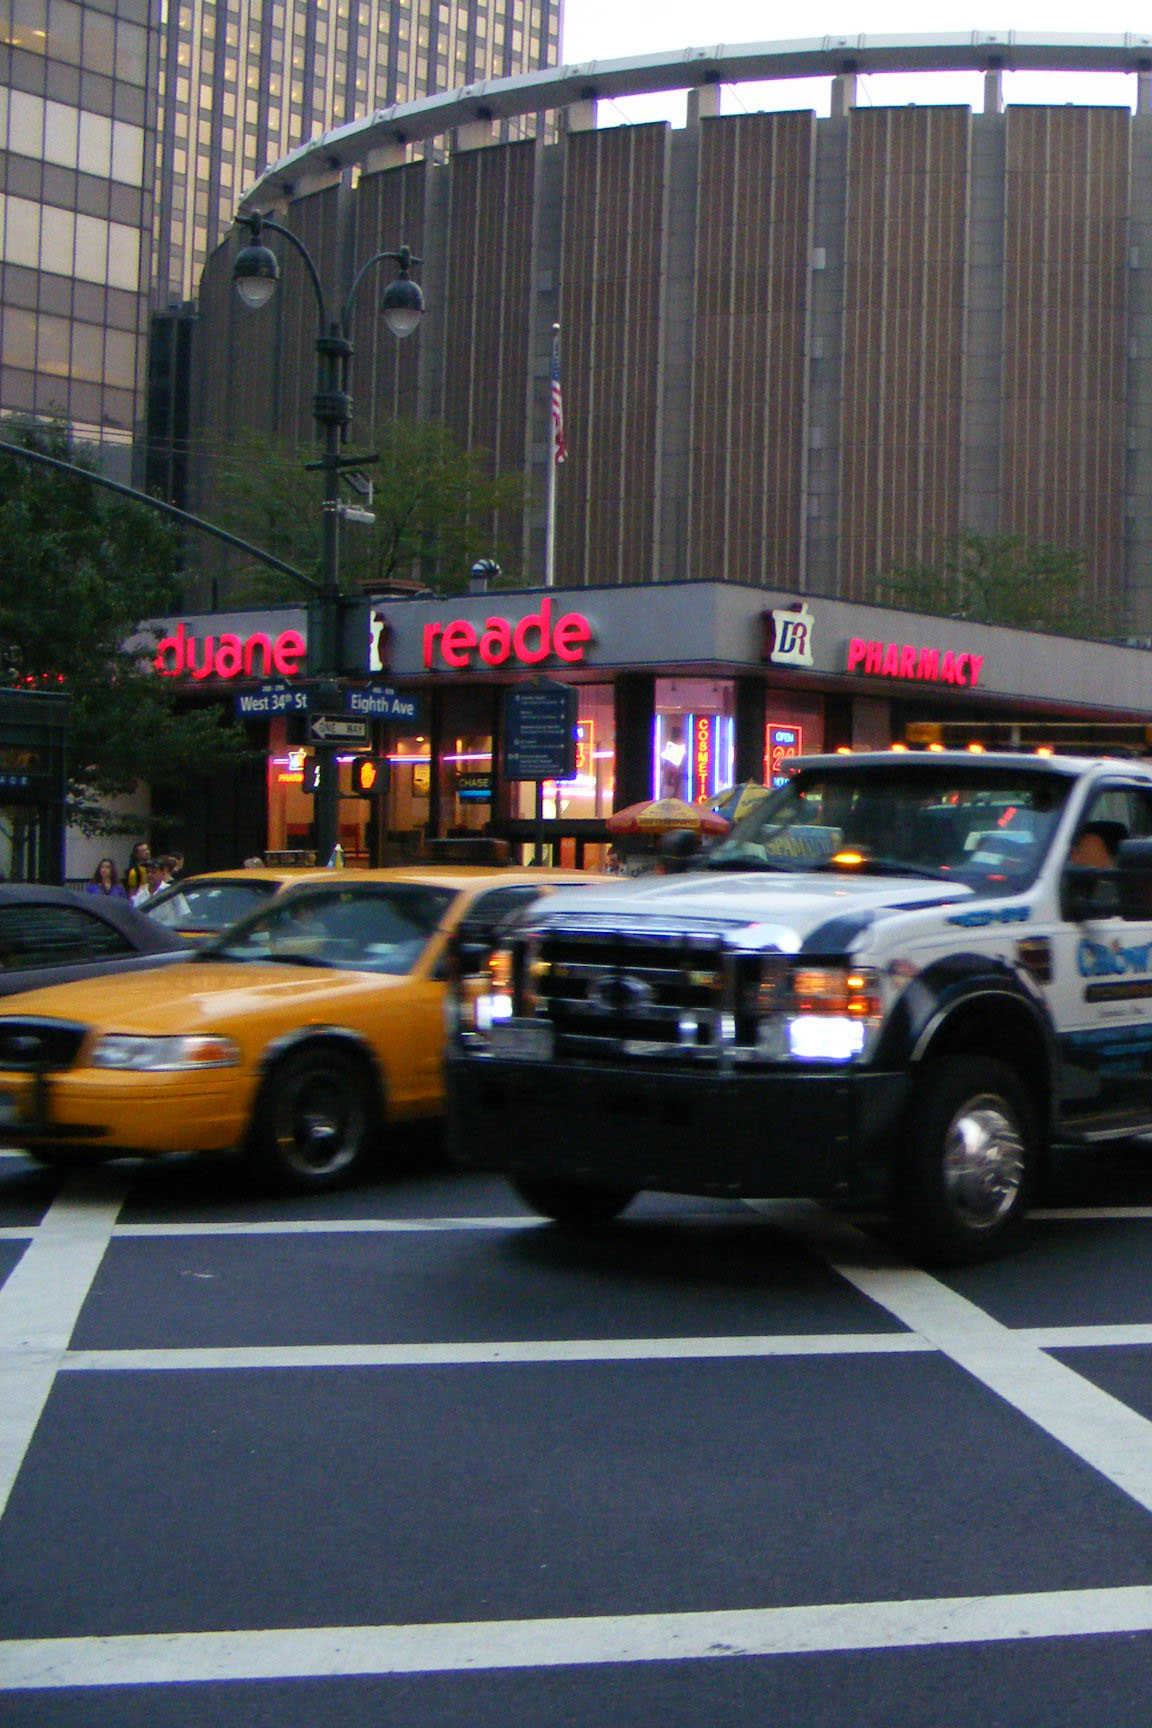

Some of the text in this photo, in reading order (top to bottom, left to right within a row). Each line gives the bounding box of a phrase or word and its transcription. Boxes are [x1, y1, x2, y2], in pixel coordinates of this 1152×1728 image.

[154, 597, 592, 680] duane reade
[847, 637, 984, 687] PHARMACY
[240, 692, 308, 712] West 34th St
[351, 694, 415, 716] Eighth Ave
[319, 721, 364, 733] ONE WAY
[775, 731, 795, 743] OPEN
[458, 777, 490, 788] CHASE
